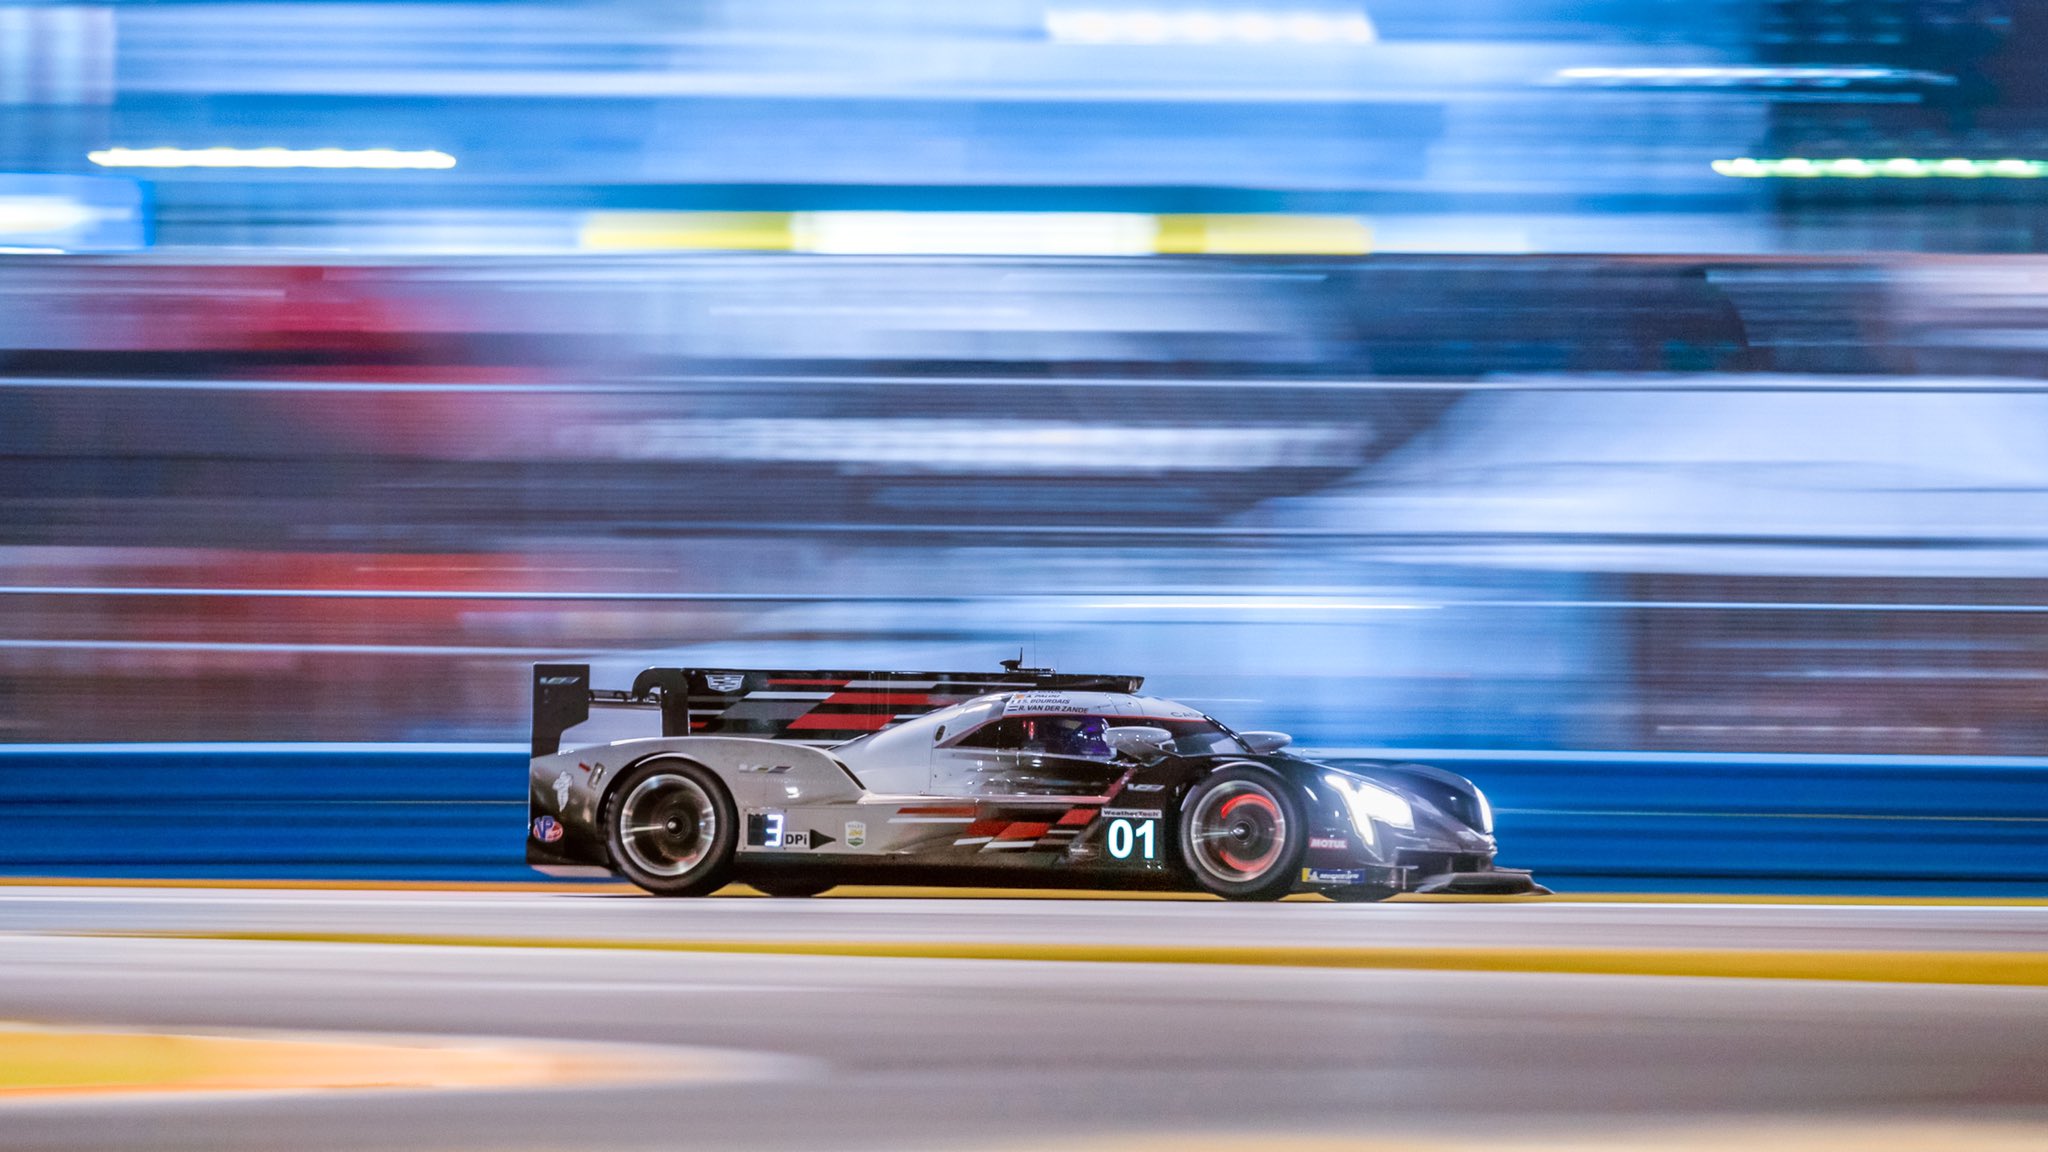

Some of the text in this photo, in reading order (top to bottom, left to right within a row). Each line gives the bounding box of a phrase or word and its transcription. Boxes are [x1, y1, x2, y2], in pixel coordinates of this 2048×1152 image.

[1061, 705, 1089, 713] ZANDE
[764, 814, 784, 847] 3
[785, 834, 807, 845] DPi
[1108, 819, 1154, 858] 01
